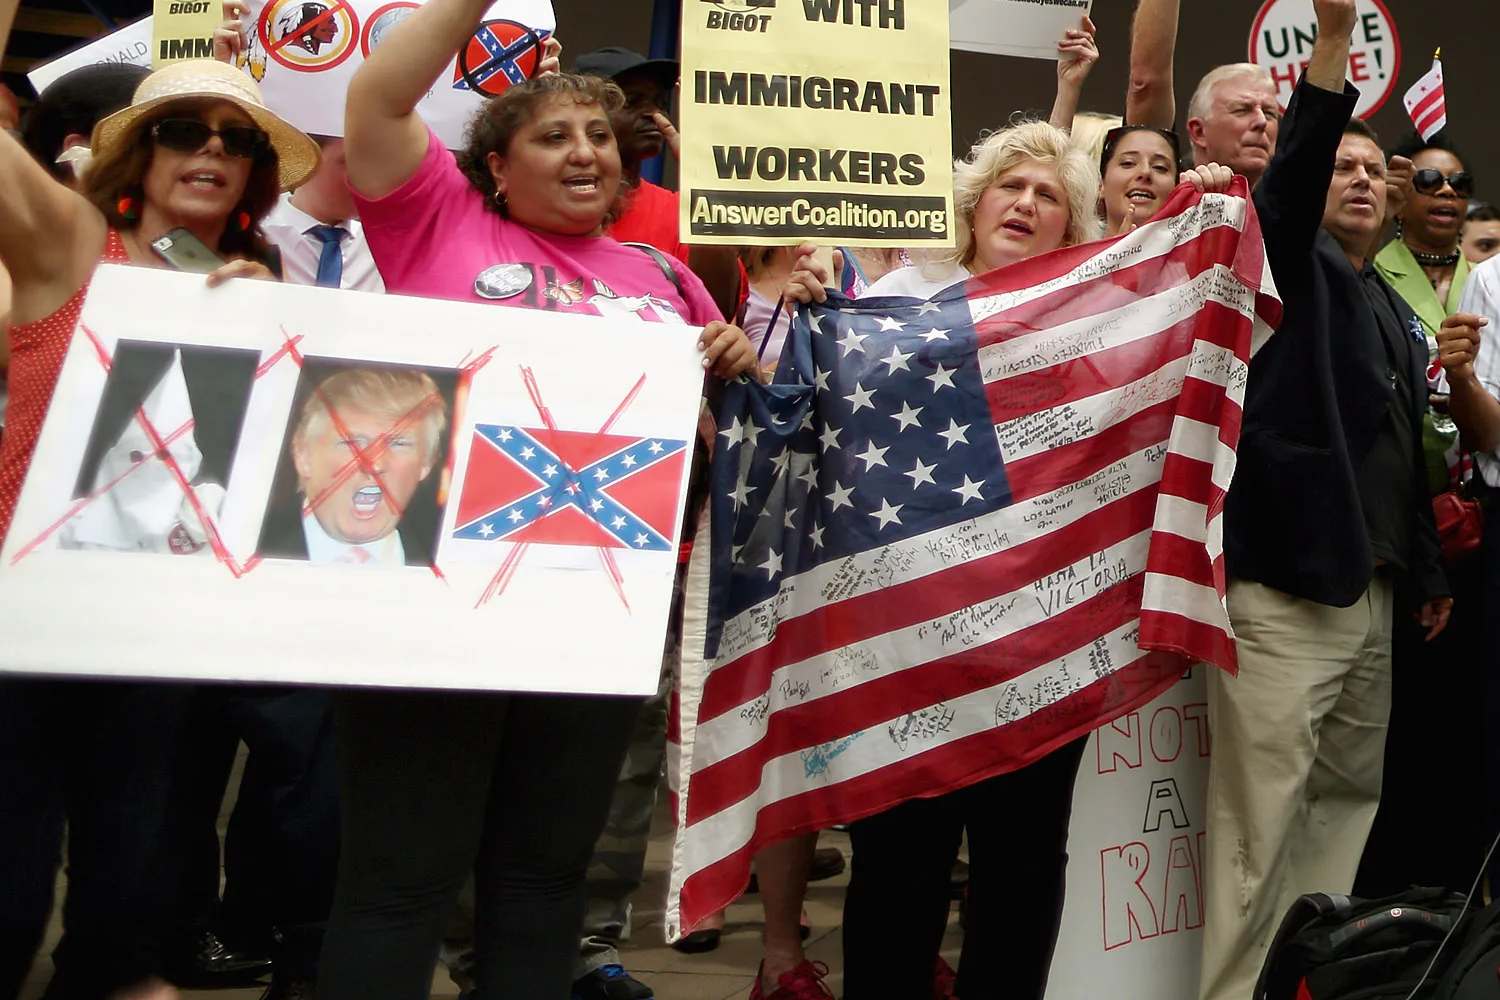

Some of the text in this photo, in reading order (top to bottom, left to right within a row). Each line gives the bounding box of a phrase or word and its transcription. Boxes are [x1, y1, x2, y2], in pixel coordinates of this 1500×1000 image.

[169, 2, 210, 15] BIGOT
[707, 10, 772, 33] BIGOT
[1263, 12, 1383, 58] UNE
[694, 70, 940, 117] IMMIGRANT
[713, 145, 926, 186] WORKERS
[692, 198, 946, 233] AnswerCoalition.org
[1034, 566, 1076, 593] HASTA
[1090, 549, 1108, 572] LA
[1036, 558, 1128, 617] VICTORIA
[1098, 703, 1211, 774] NOT
[1143, 778, 1190, 833] A
[1101, 831, 1206, 951] RA
